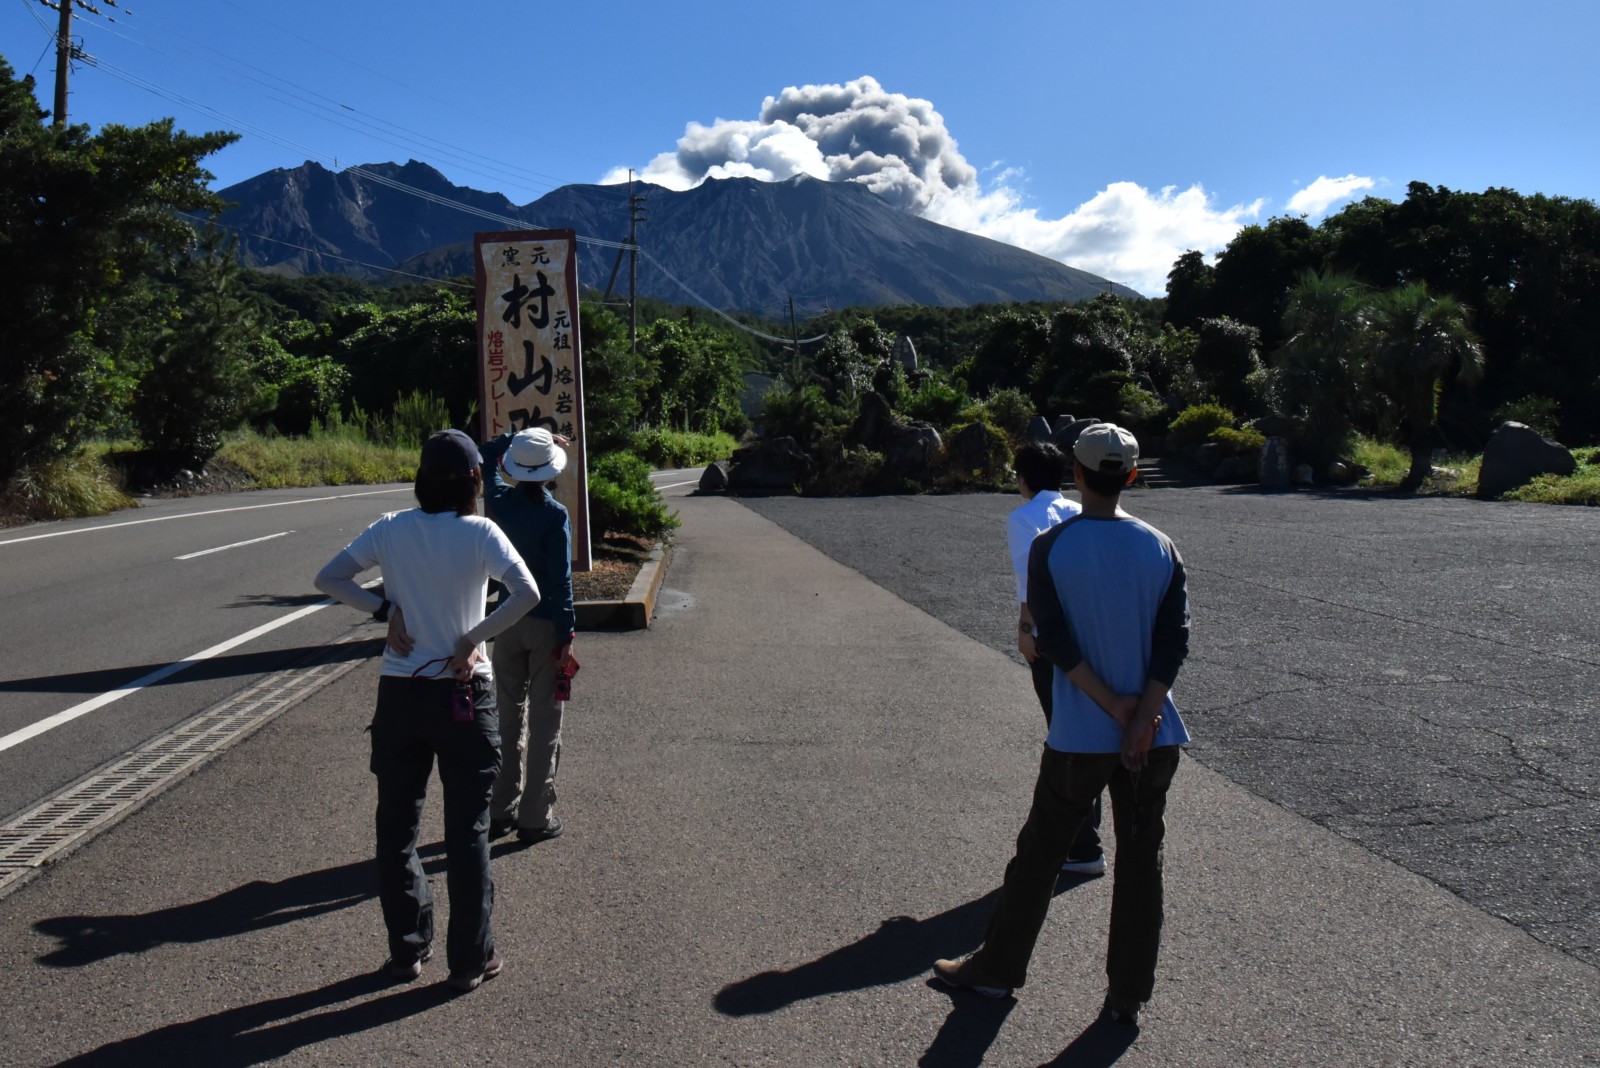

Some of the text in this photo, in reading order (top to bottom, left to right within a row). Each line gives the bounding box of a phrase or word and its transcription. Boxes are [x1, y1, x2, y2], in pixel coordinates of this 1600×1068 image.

[488, 330, 508, 439] 熔岩プレート
